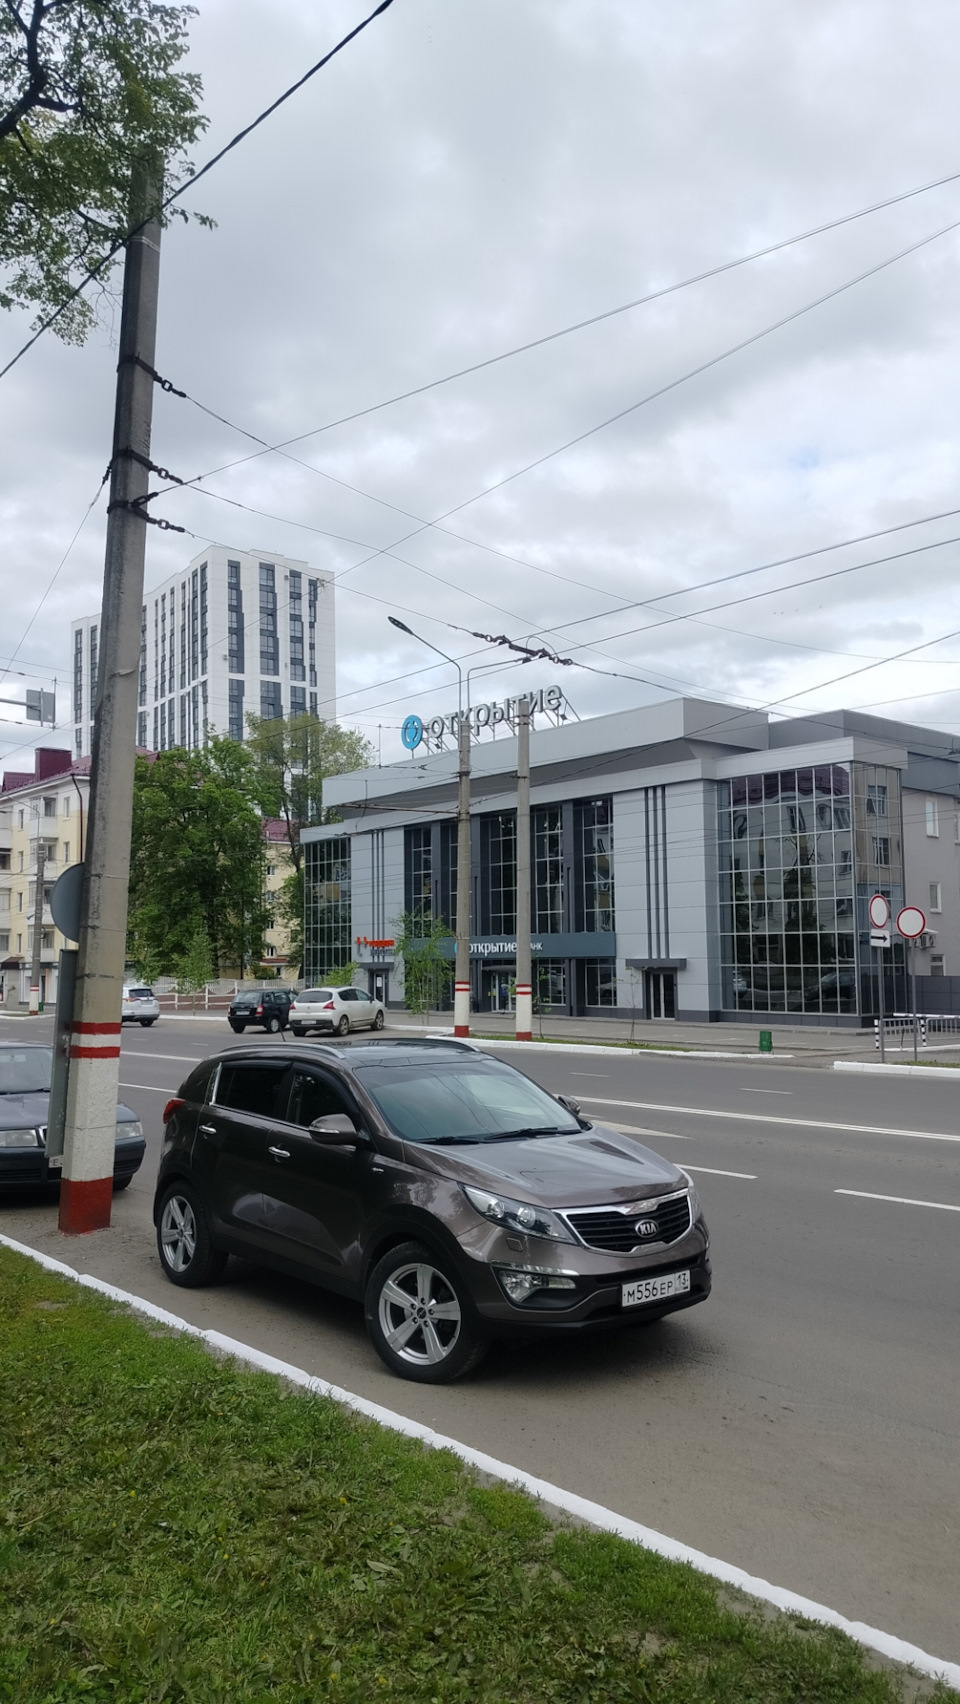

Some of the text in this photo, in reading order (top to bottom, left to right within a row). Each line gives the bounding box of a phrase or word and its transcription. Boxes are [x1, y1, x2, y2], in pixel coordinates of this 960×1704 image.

[428, 685, 562, 736] открытие
[469, 942, 543, 956] открытие АНК
[640, 1223, 657, 1234] KIA
